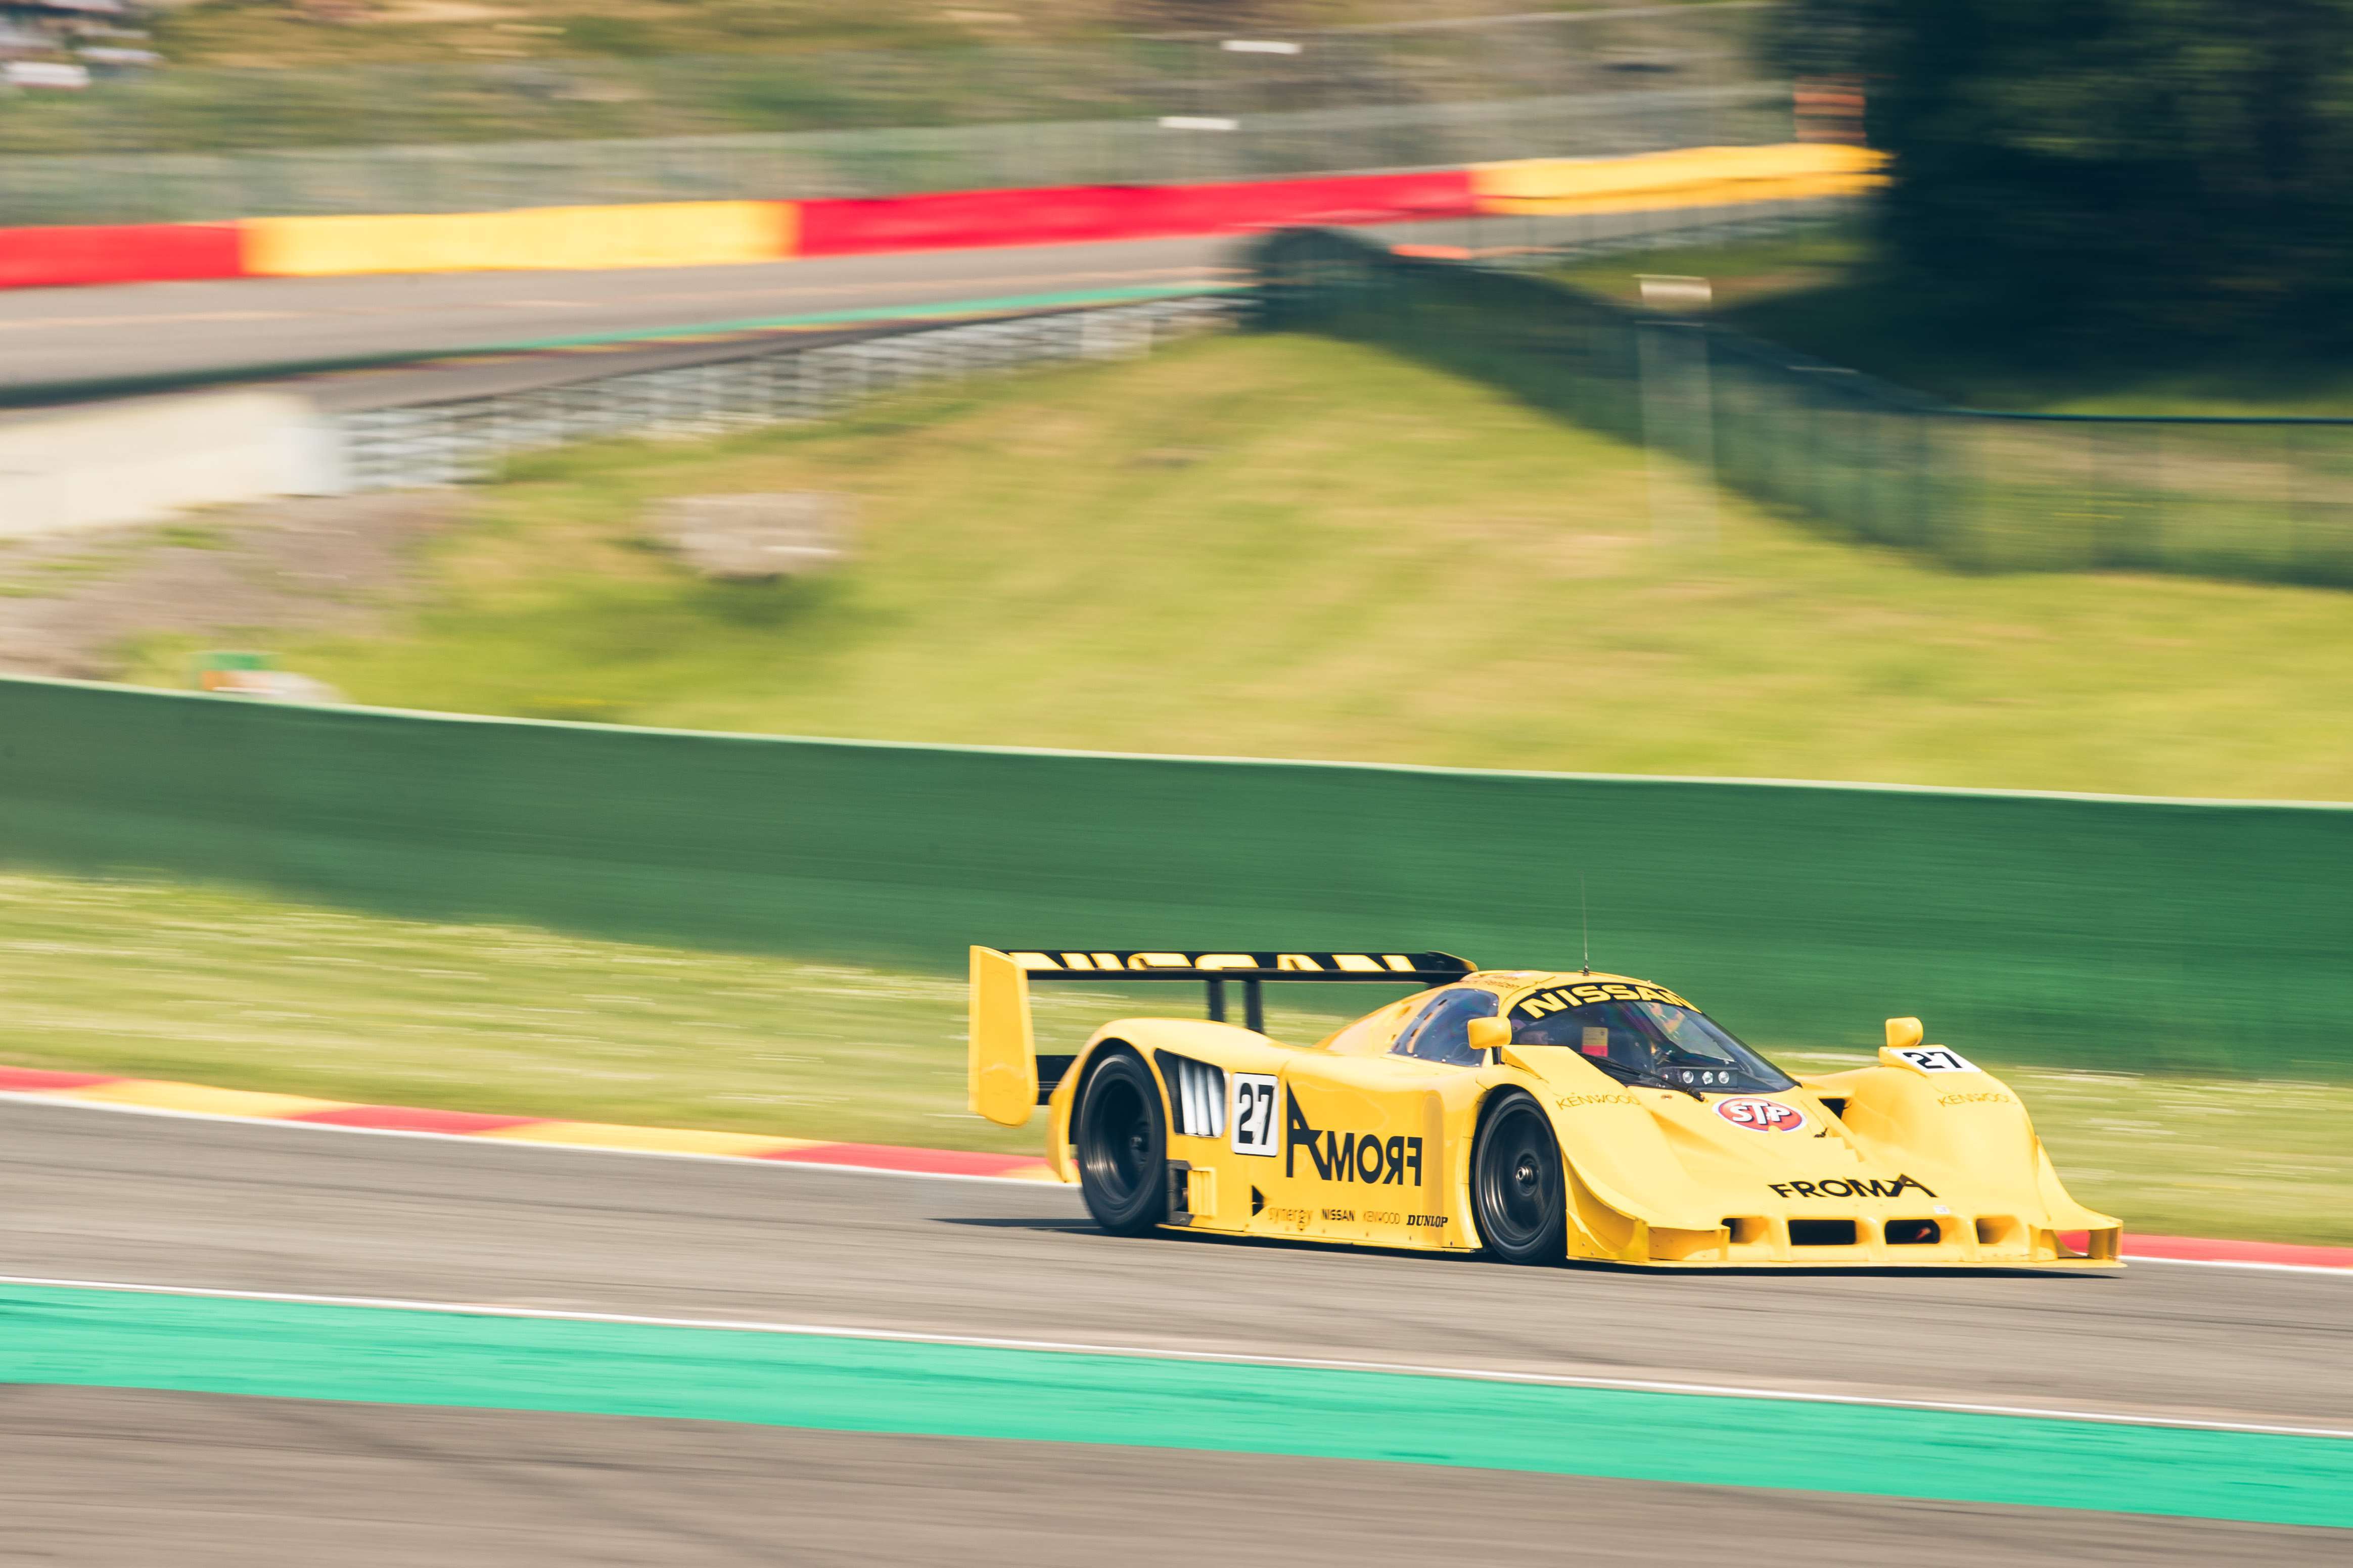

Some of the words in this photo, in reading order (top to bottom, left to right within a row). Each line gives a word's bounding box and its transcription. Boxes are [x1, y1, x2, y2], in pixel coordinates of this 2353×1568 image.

[1519, 985, 1702, 1018] NISSAN
[1903, 1052, 1962, 1069] 27
[1556, 1094, 1641, 1110] KENWOOD
[1937, 1093, 2017, 1107] KENWOO
[1238, 1082, 1274, 1145] 27
[1730, 1102, 1791, 1125] STP
[1767, 1174, 1938, 1198] FROMA
[1322, 1209, 1354, 1221] NISSAN
[1407, 1215, 1448, 1227] DUNLOP
